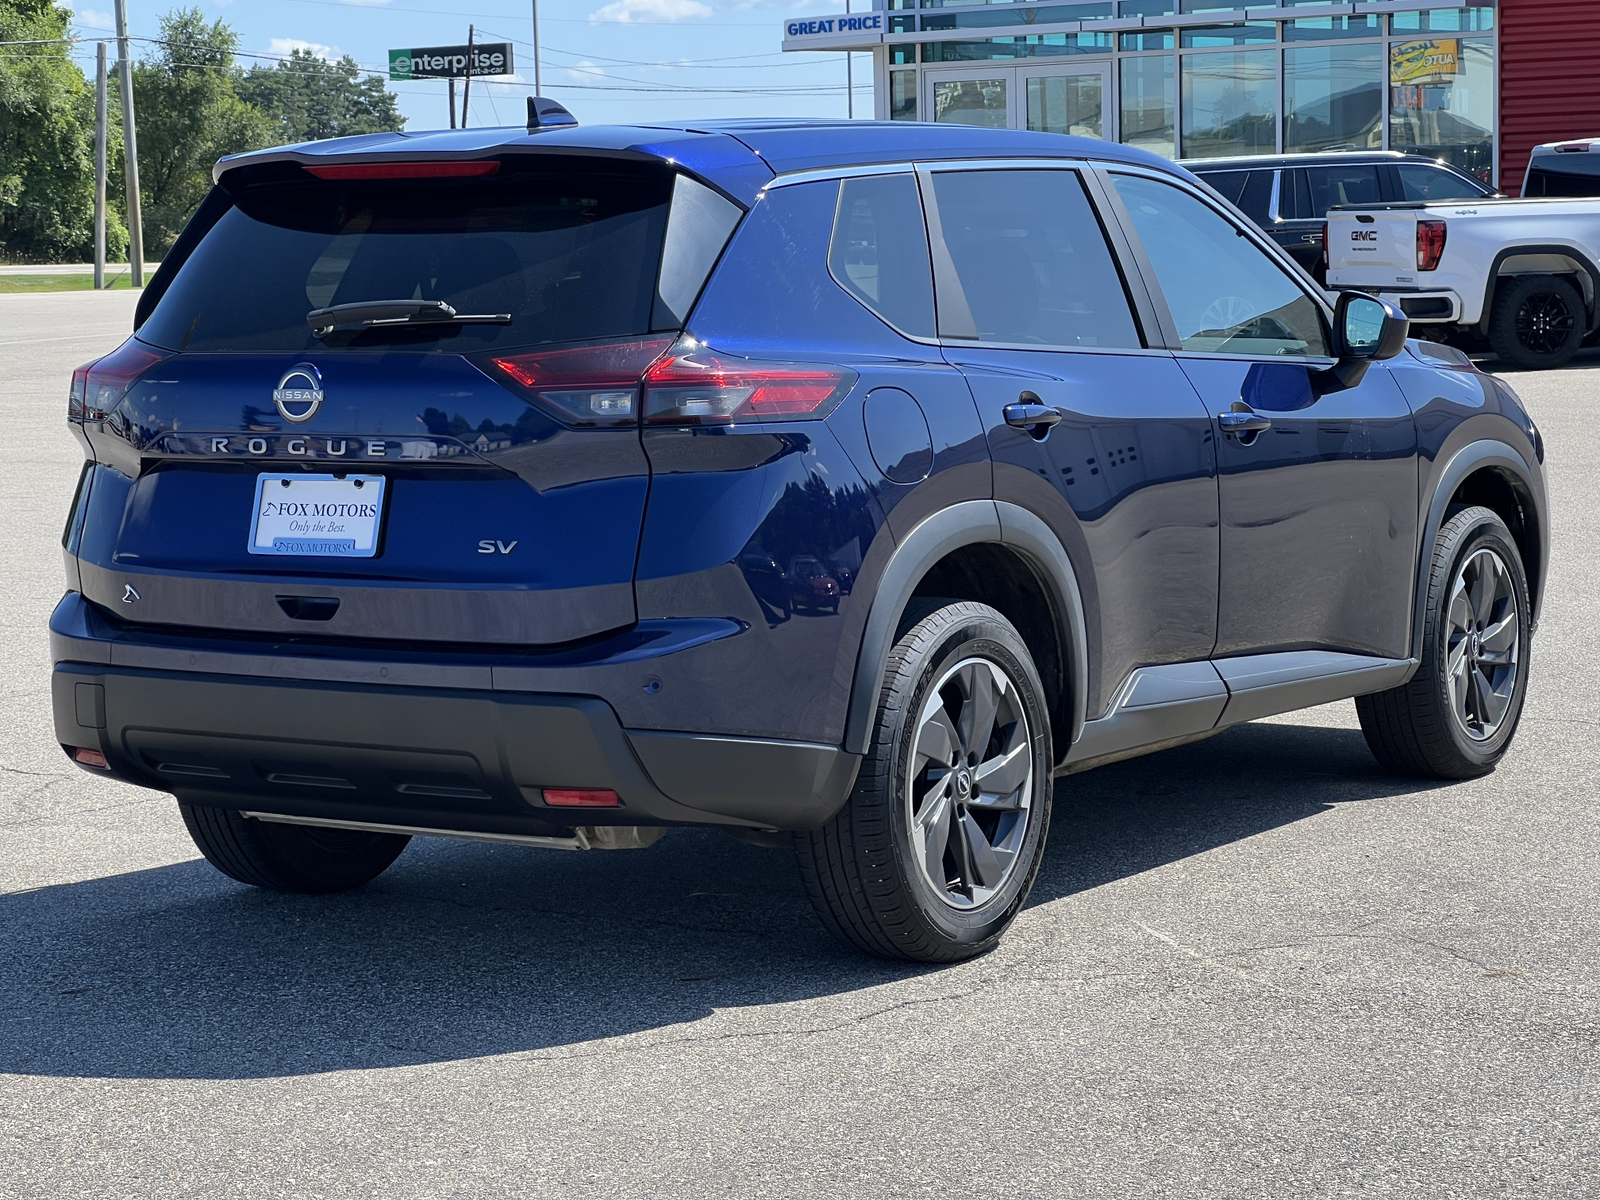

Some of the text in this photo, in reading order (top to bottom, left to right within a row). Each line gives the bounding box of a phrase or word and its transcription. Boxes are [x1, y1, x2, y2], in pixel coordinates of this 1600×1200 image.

[787, 16, 881, 36] GREAT PRICE
[463, 67, 504, 75] rnt-a-car
[1351, 231, 1377, 241] GMC
[274, 390, 322, 400] NISSAN
[211, 438, 386, 455] ROGUE
[278, 502, 377, 517] FOX MOTORS
[289, 519, 346, 535] Only the Best.
[286, 542, 347, 553] FOX MOTORS
[477, 540, 518, 554] SV
